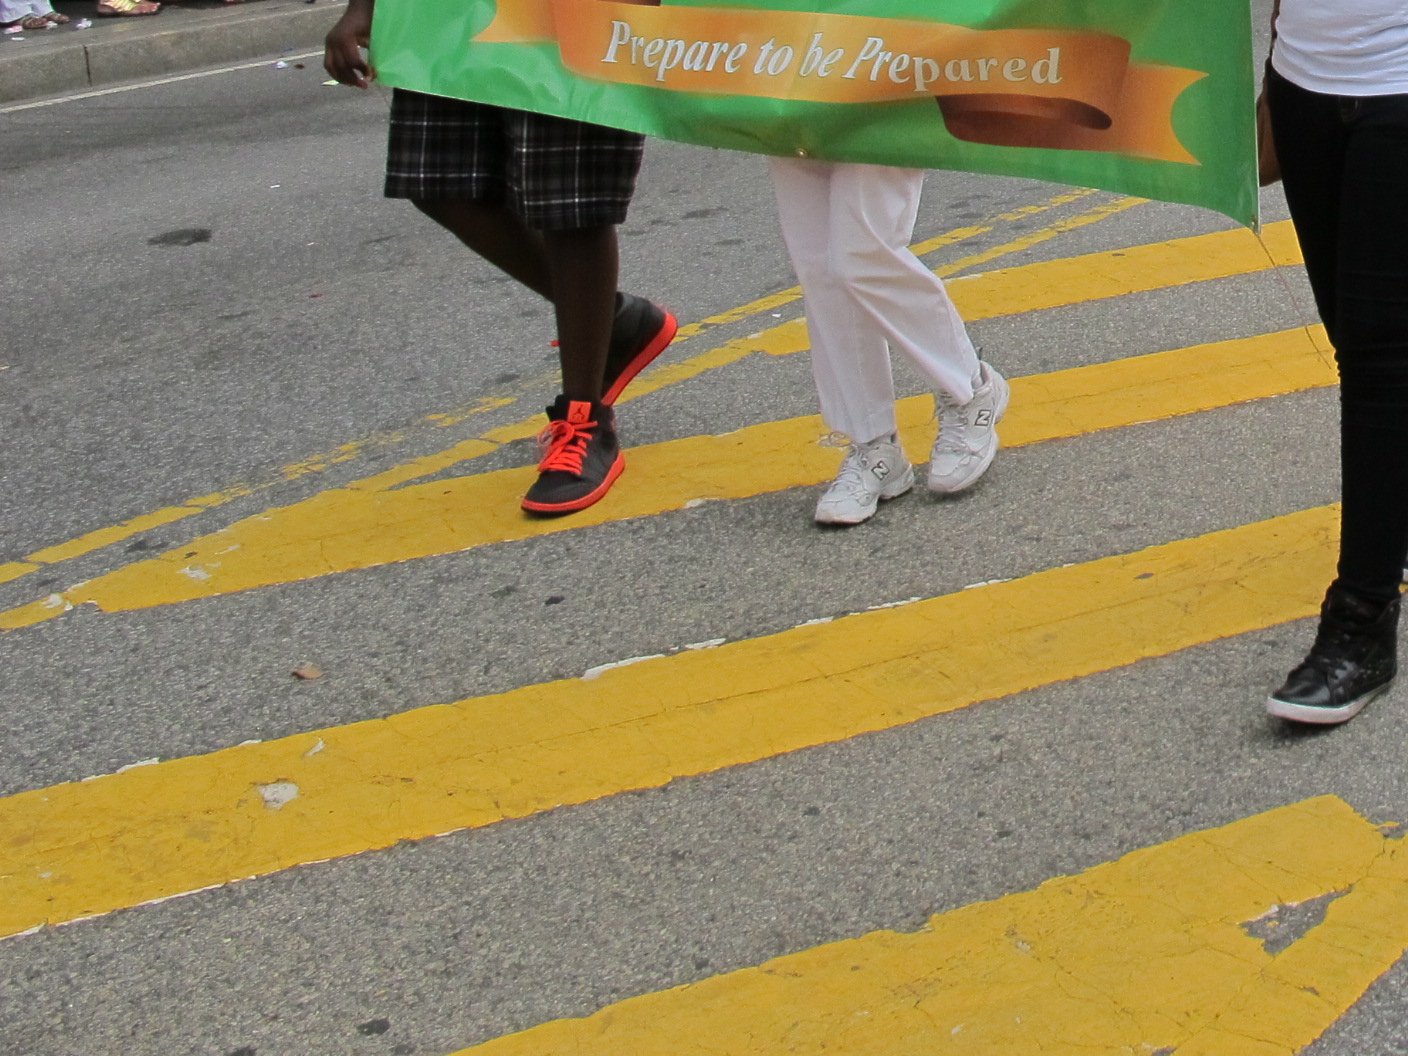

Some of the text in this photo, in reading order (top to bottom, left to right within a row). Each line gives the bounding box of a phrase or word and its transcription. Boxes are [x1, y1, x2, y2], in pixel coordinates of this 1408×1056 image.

[601, 19, 1063, 92] Prepare to be Prepared
